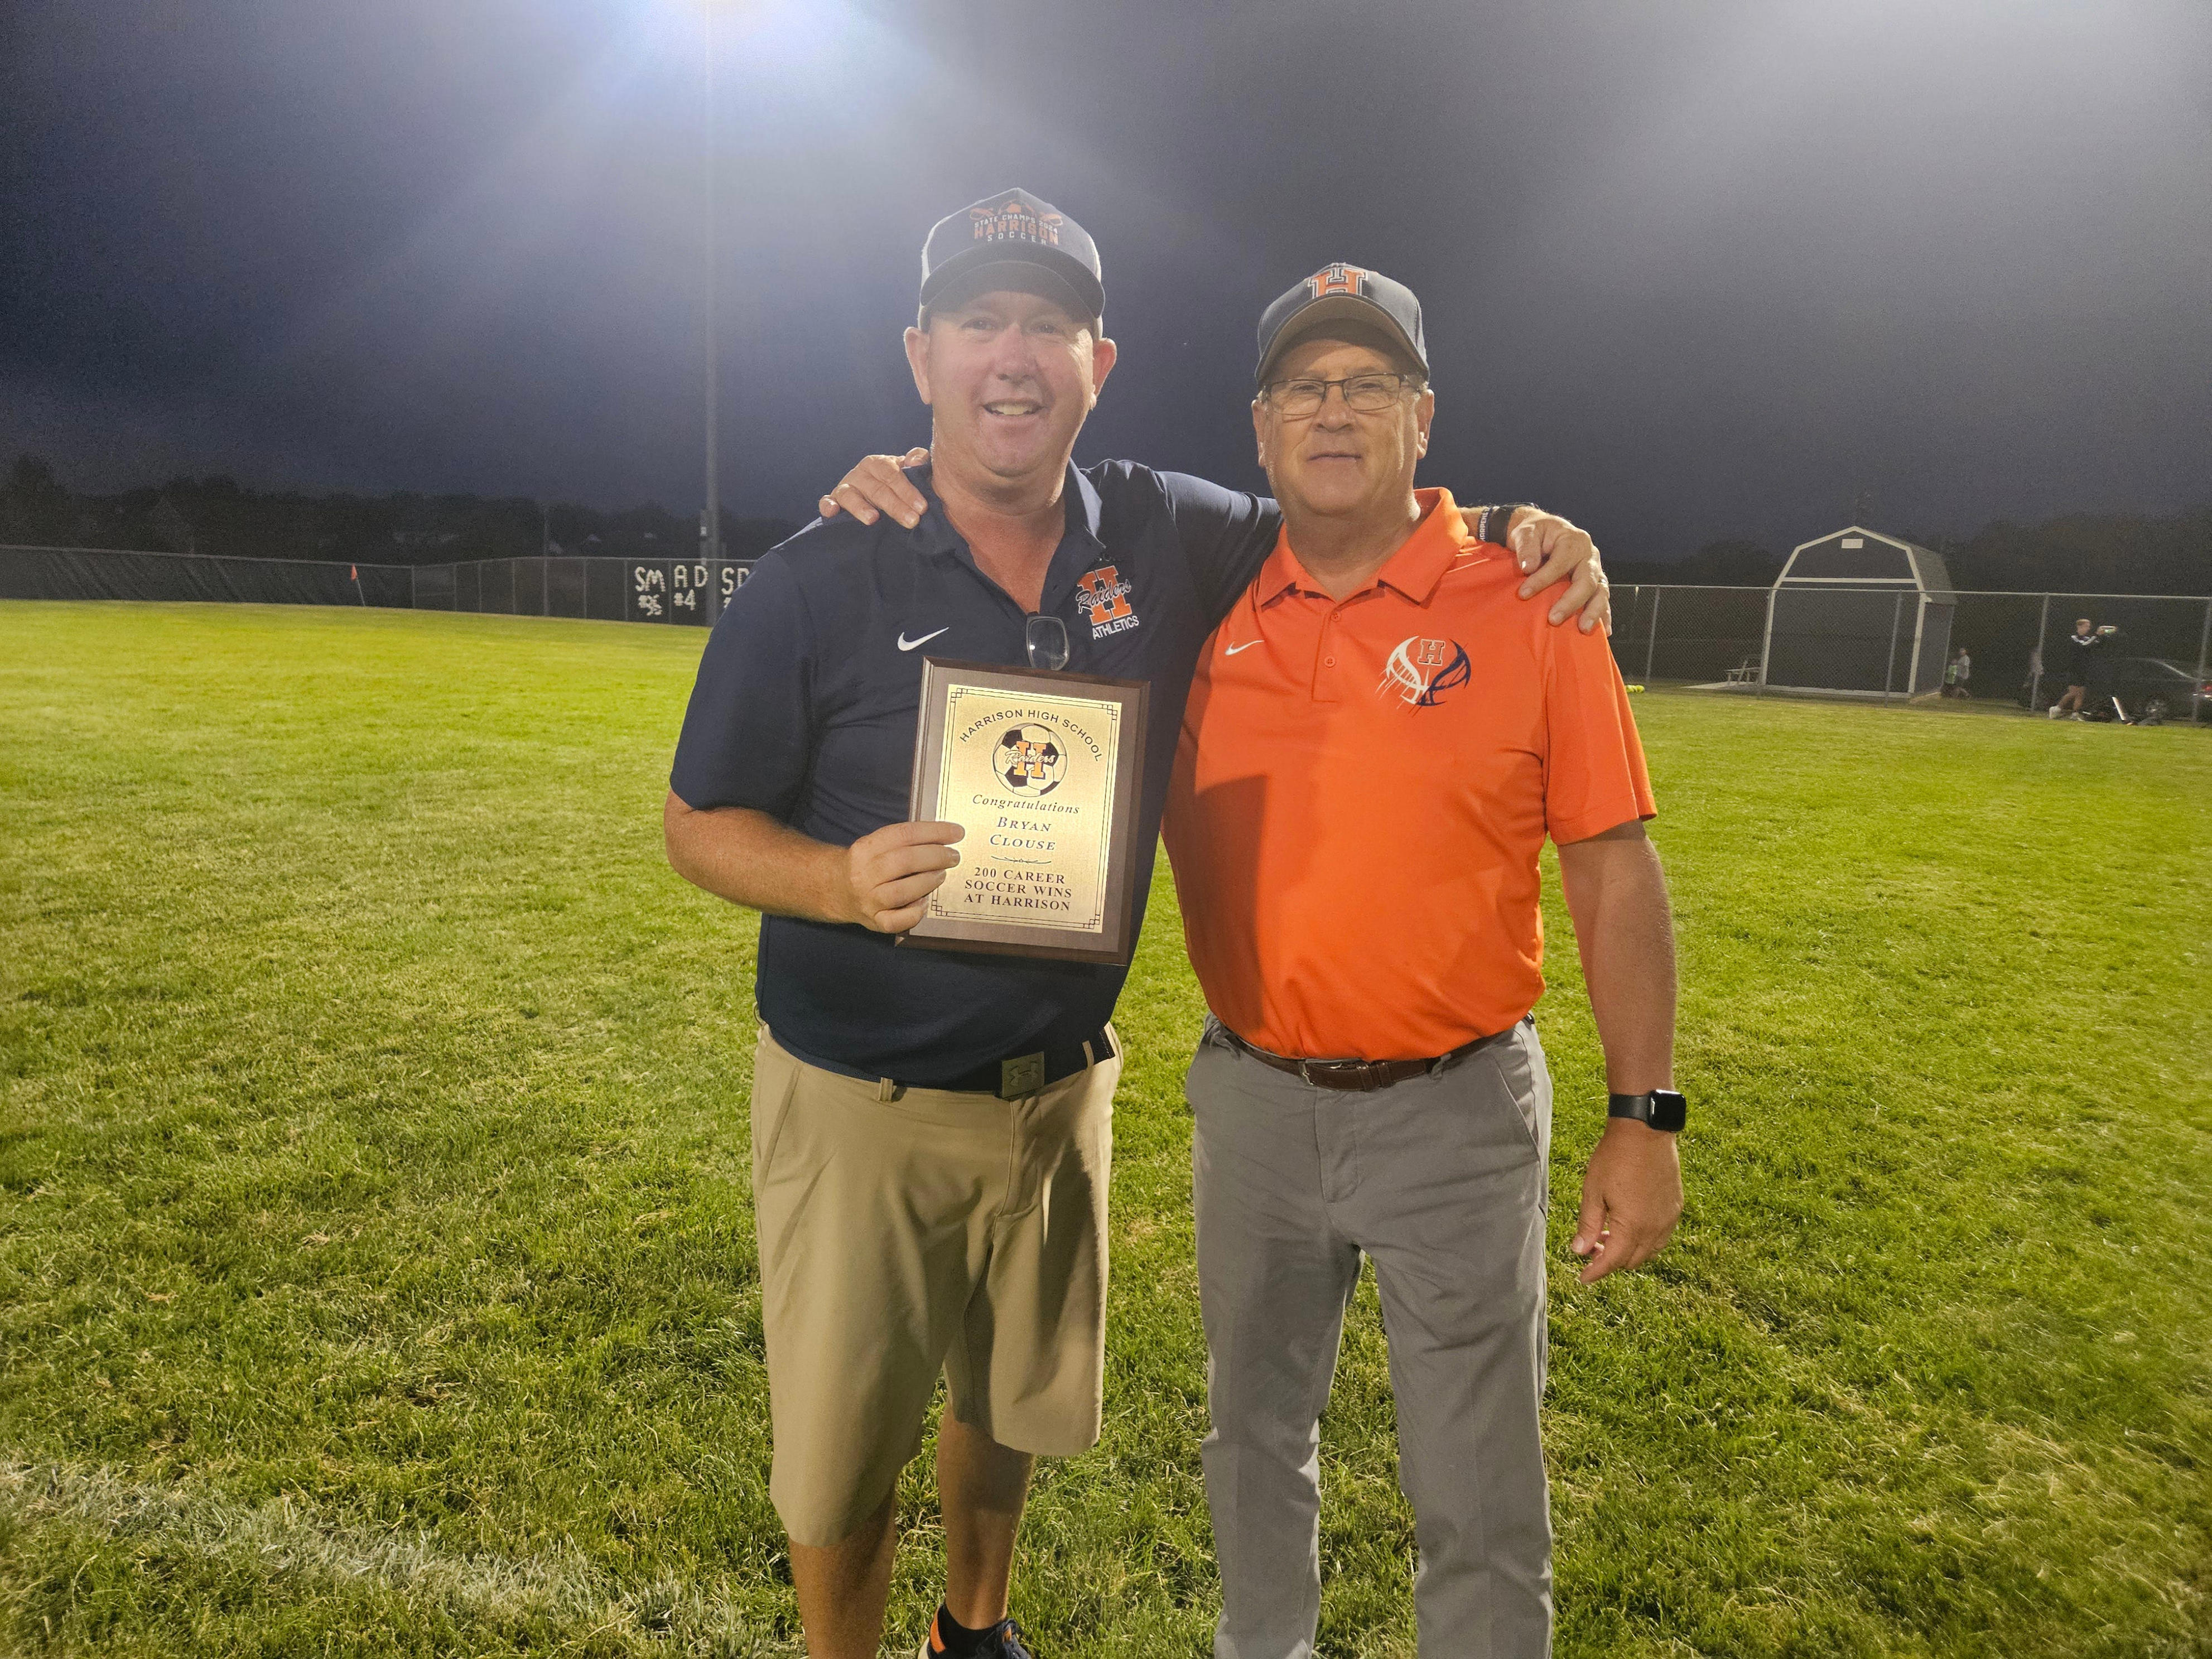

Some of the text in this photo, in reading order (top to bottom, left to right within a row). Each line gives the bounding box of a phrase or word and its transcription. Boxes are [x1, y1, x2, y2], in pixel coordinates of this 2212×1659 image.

[975, 216, 998, 228] STATE
[1002, 214, 1035, 224] CHAMPS
[974, 219, 1058, 245] HARRISON
[987, 231, 1046, 245] SOCCER
[1308, 267, 1367, 299] H
[635, 566, 666, 592] SM
[1076, 579, 1131, 614] Raiders
[1092, 615, 1139, 639] ATHLETICS
[1418, 639, 1445, 665] H
[960, 709, 1103, 762] HARRISON HIGH SCHOOL
[1005, 750, 1056, 764] Raiders
[972, 794, 1080, 814] Congratulations
[996, 816, 1052, 832] BRYAN
[990, 834, 1056, 850] CLOUSE
[974, 867, 1065, 884] 200 CAREER
[965, 879, 1072, 898] SOCCER WINS
[964, 894, 1071, 911] AT HARRISON
